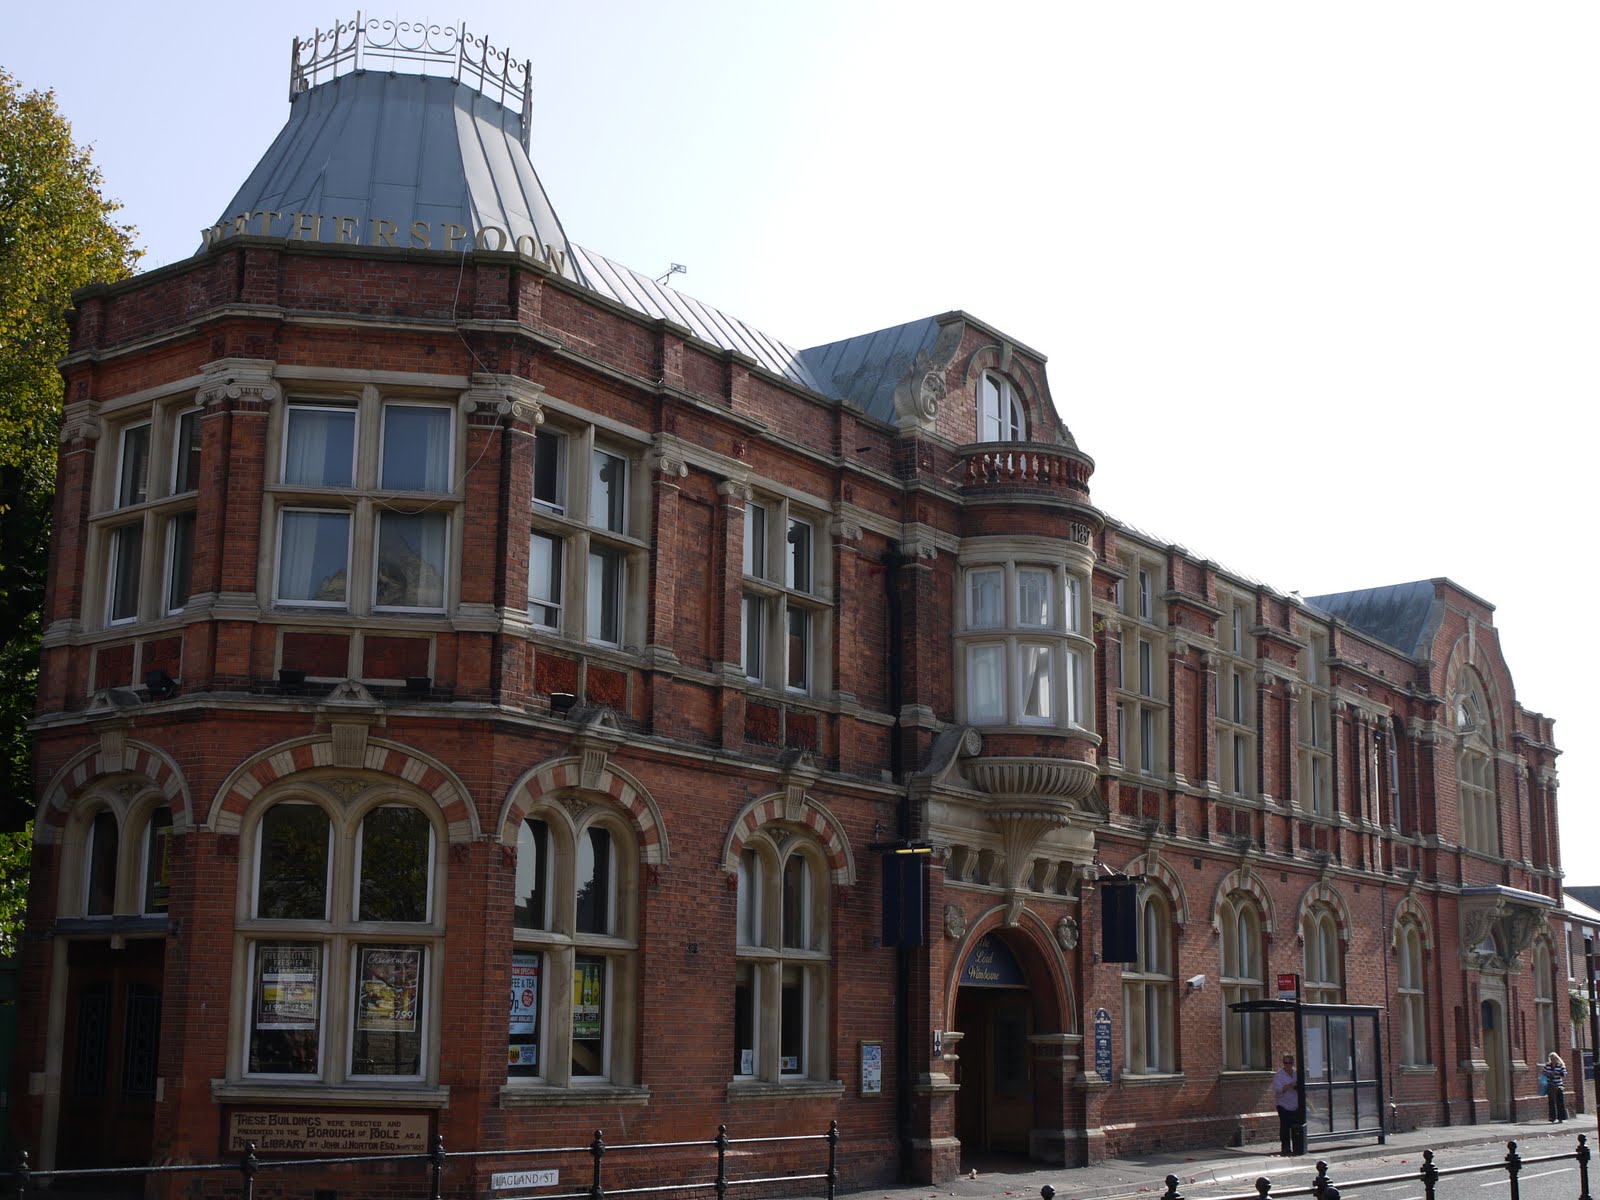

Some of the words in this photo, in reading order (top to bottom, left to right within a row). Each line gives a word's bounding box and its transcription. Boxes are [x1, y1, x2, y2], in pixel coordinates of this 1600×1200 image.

[200, 210, 567, 277] WETHERSPOON
[273, 959, 304, 967] FRESHER
[975, 951, 994, 964] Lord
[968, 965, 1000, 981] Wimborne
[526, 978, 536, 989] TEA
[234, 1114, 267, 1126] THESE
[268, 1114, 321, 1126] BUILDINGS
[326, 1119, 344, 1127] WERE
[237, 1128, 273, 1136] PRESENTED
[306, 1126, 355, 1138] BOROUGH
[369, 1128, 400, 1140] POOLE
[261, 1135, 307, 1149] LIBRARY
[320, 1139, 340, 1150] JOHN
[496, 1173, 539, 1187] LAGLAND
[544, 1172, 555, 1184] ST
